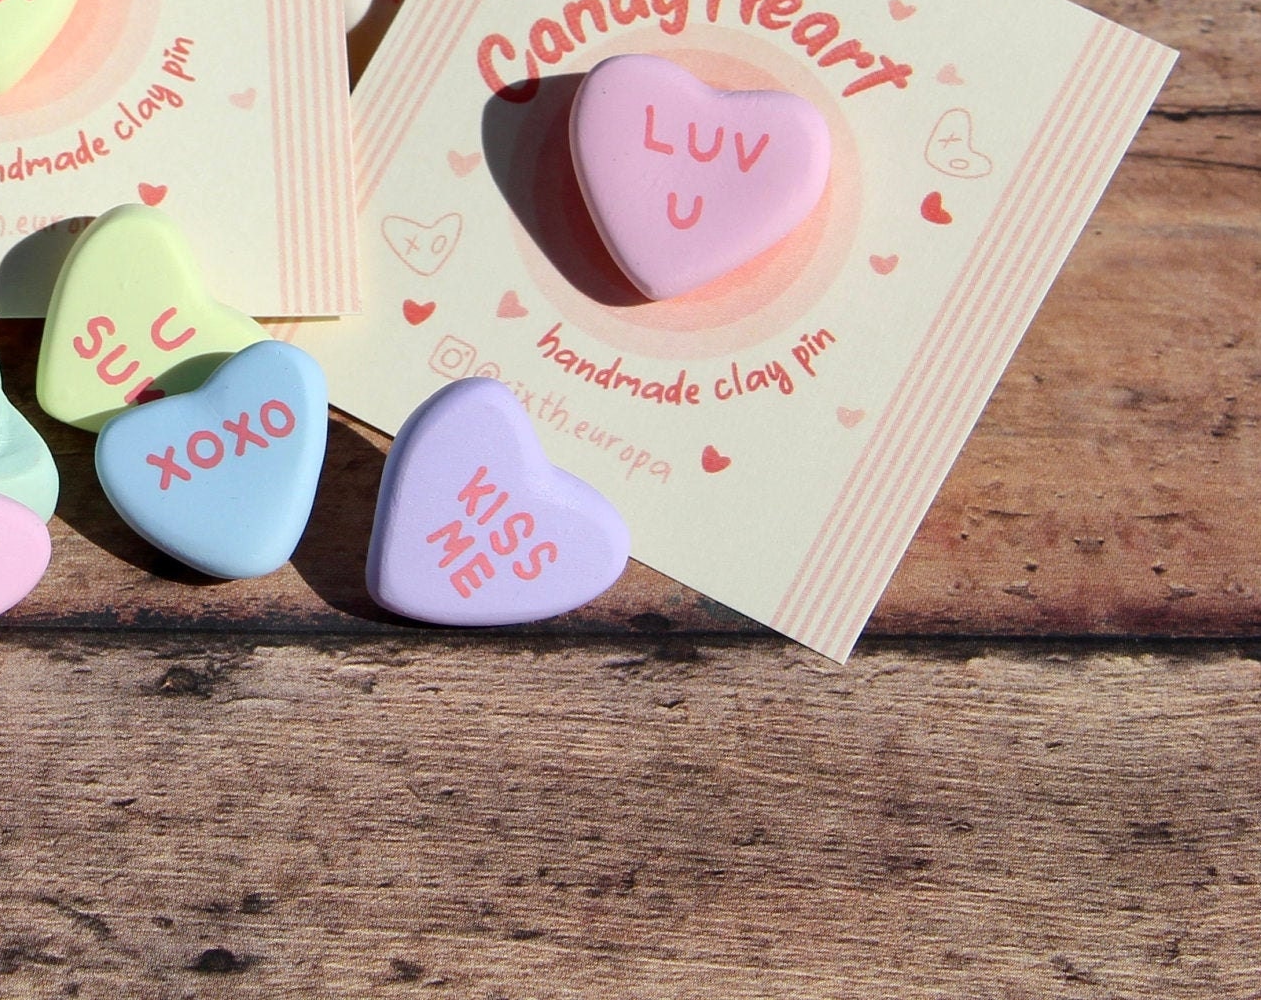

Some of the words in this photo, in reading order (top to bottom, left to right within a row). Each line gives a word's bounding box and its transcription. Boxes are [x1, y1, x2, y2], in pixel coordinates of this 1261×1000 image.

[113, 83, 185, 141] clay
[161, 36, 196, 82] pin
[644, 104, 770, 173] LUV
[667, 192, 704, 230] U
[150, 306, 196, 352] U
[536, 322, 701, 405] handmade
[714, 360, 795, 401] clay
[791, 328, 836, 377] pin
[146, 399, 296, 491] XOXO
[425, 519, 496, 599] ME
[457, 465, 558, 581] KISS
